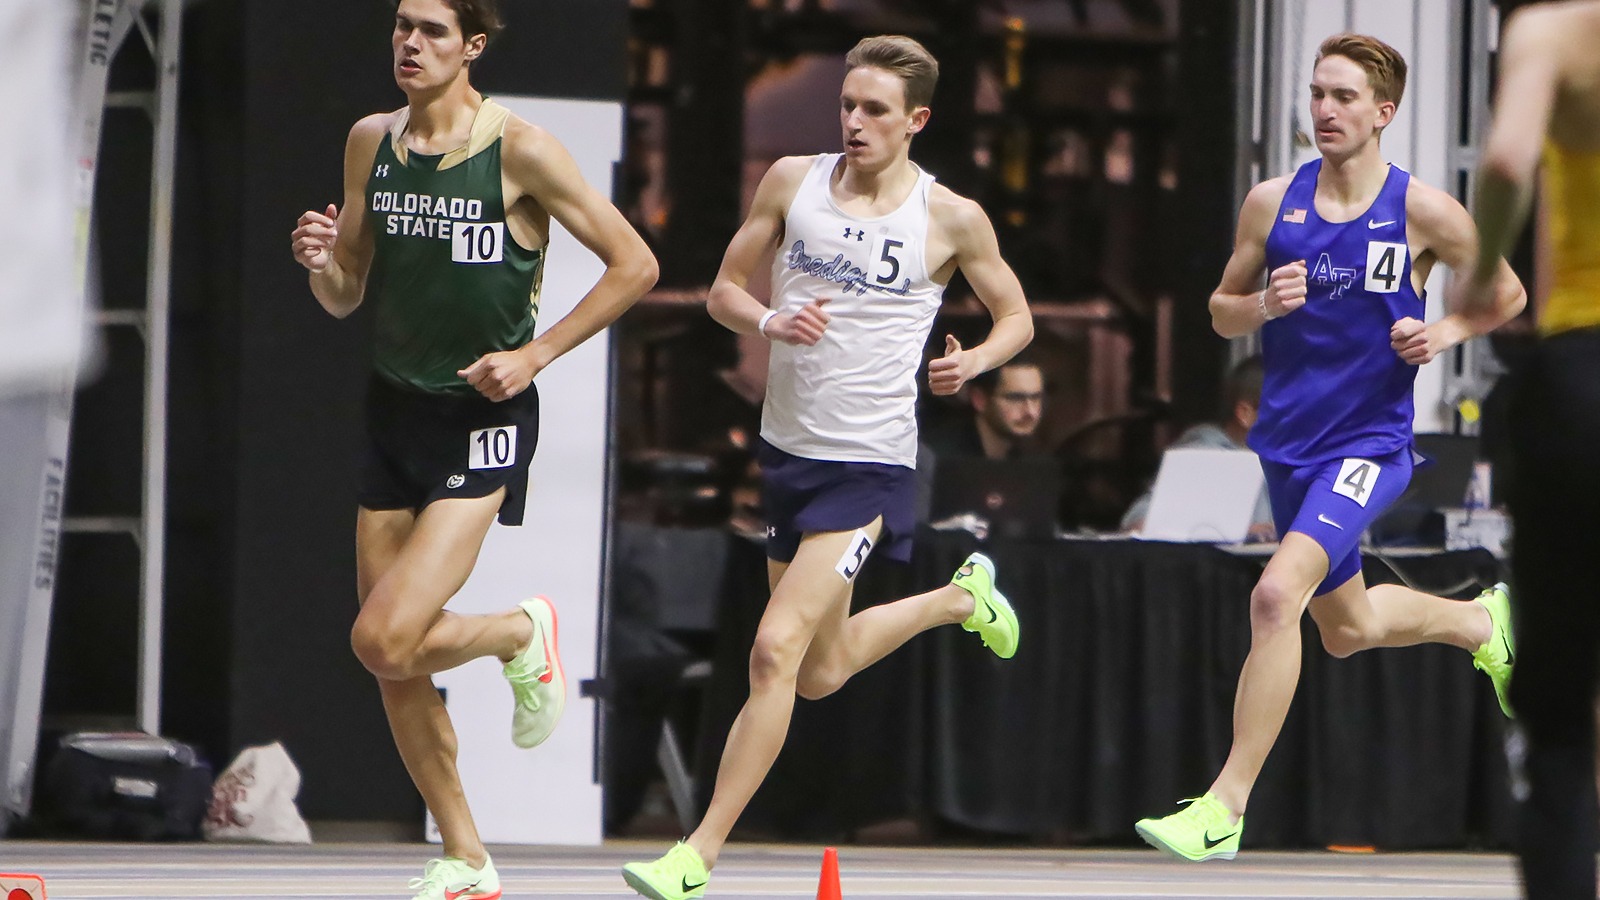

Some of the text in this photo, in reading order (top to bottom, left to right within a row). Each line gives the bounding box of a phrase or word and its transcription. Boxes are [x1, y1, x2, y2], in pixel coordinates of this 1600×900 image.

[372, 191, 483, 220] COLORADO
[386, 214, 451, 240] STATE
[461, 225, 496, 261] 10
[876, 238, 904, 285] 5
[1310, 252, 1357, 300] AF
[1372, 246, 1397, 290] 4
[476, 428, 510, 466] 10
[1342, 462, 1371, 499] 4
[843, 536, 872, 579] 5
